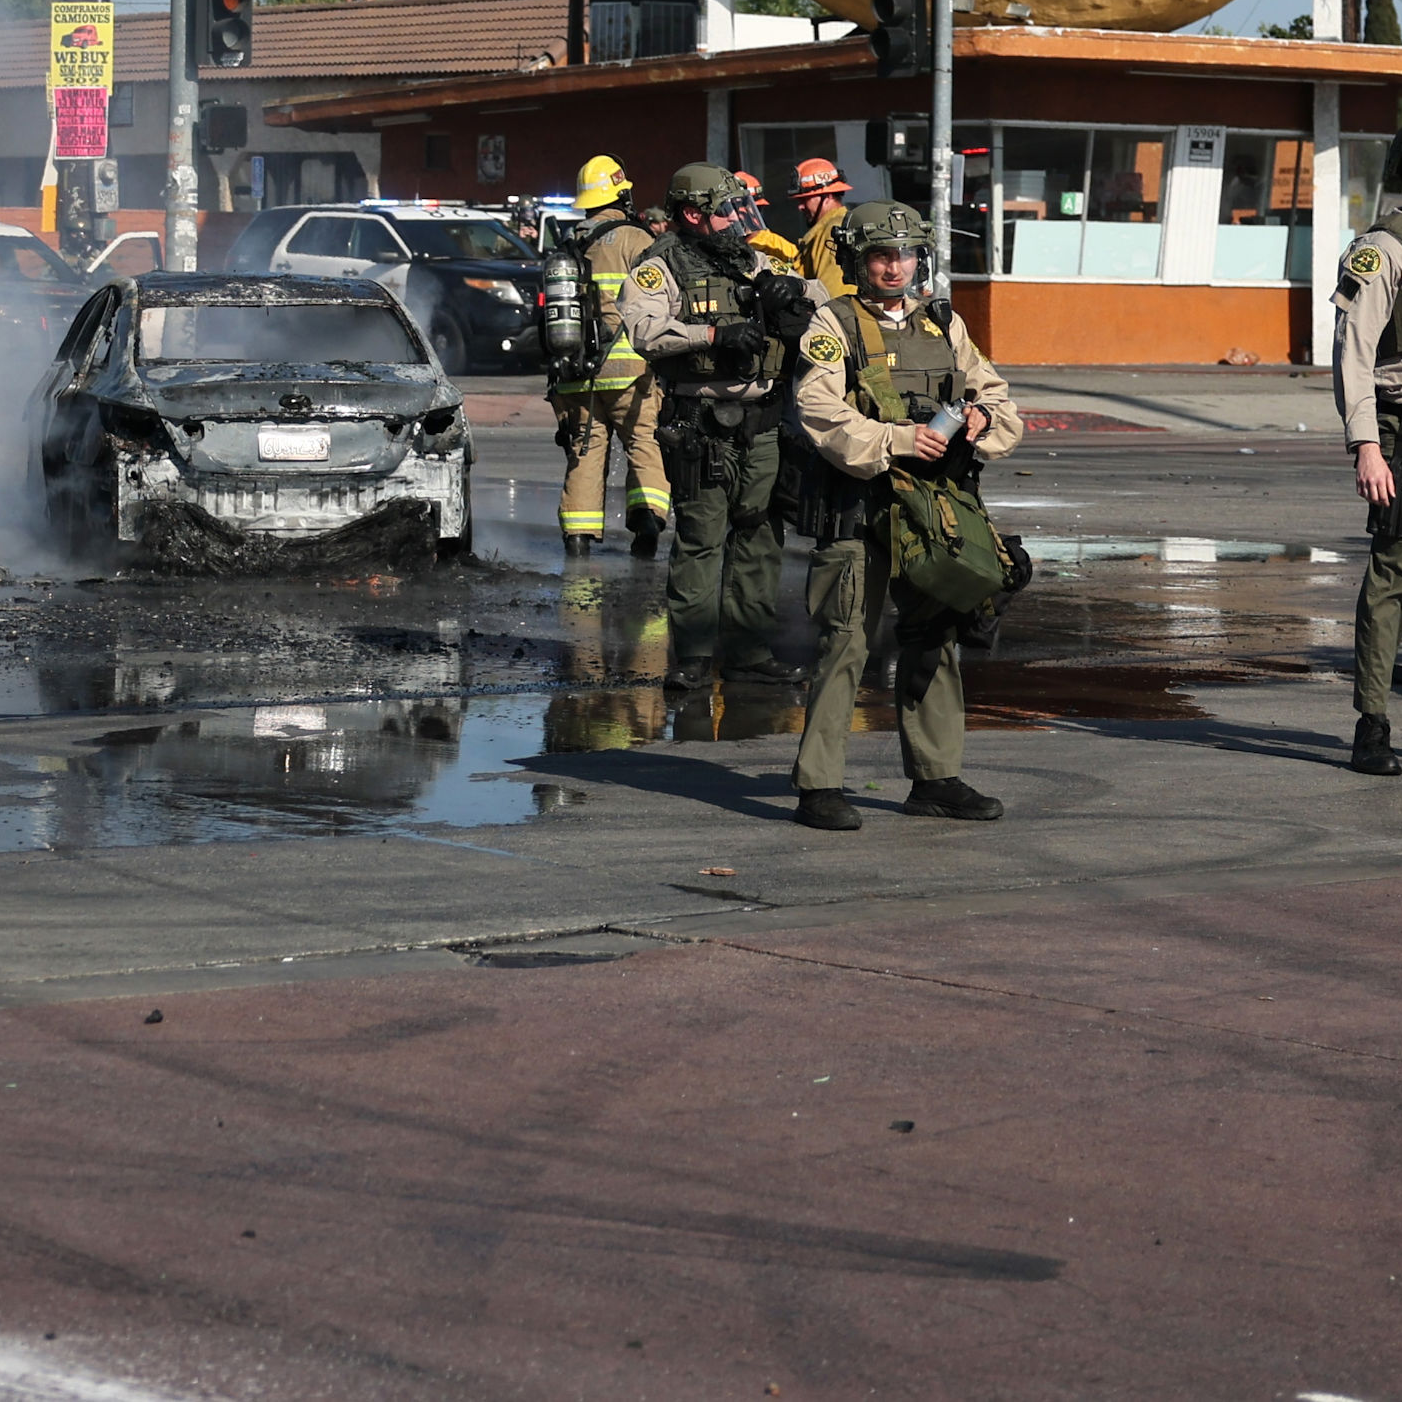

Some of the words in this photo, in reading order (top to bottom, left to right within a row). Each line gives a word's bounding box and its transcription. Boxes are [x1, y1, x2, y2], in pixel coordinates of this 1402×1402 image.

[54, 5, 111, 13] COMPRAMOS
[54, 14, 111, 23] CAMIONES
[54, 51, 77, 64] WE
[80, 51, 109, 64] BUY
[1186, 127, 1220, 138] 15904
[1064, 197, 1073, 210] A
